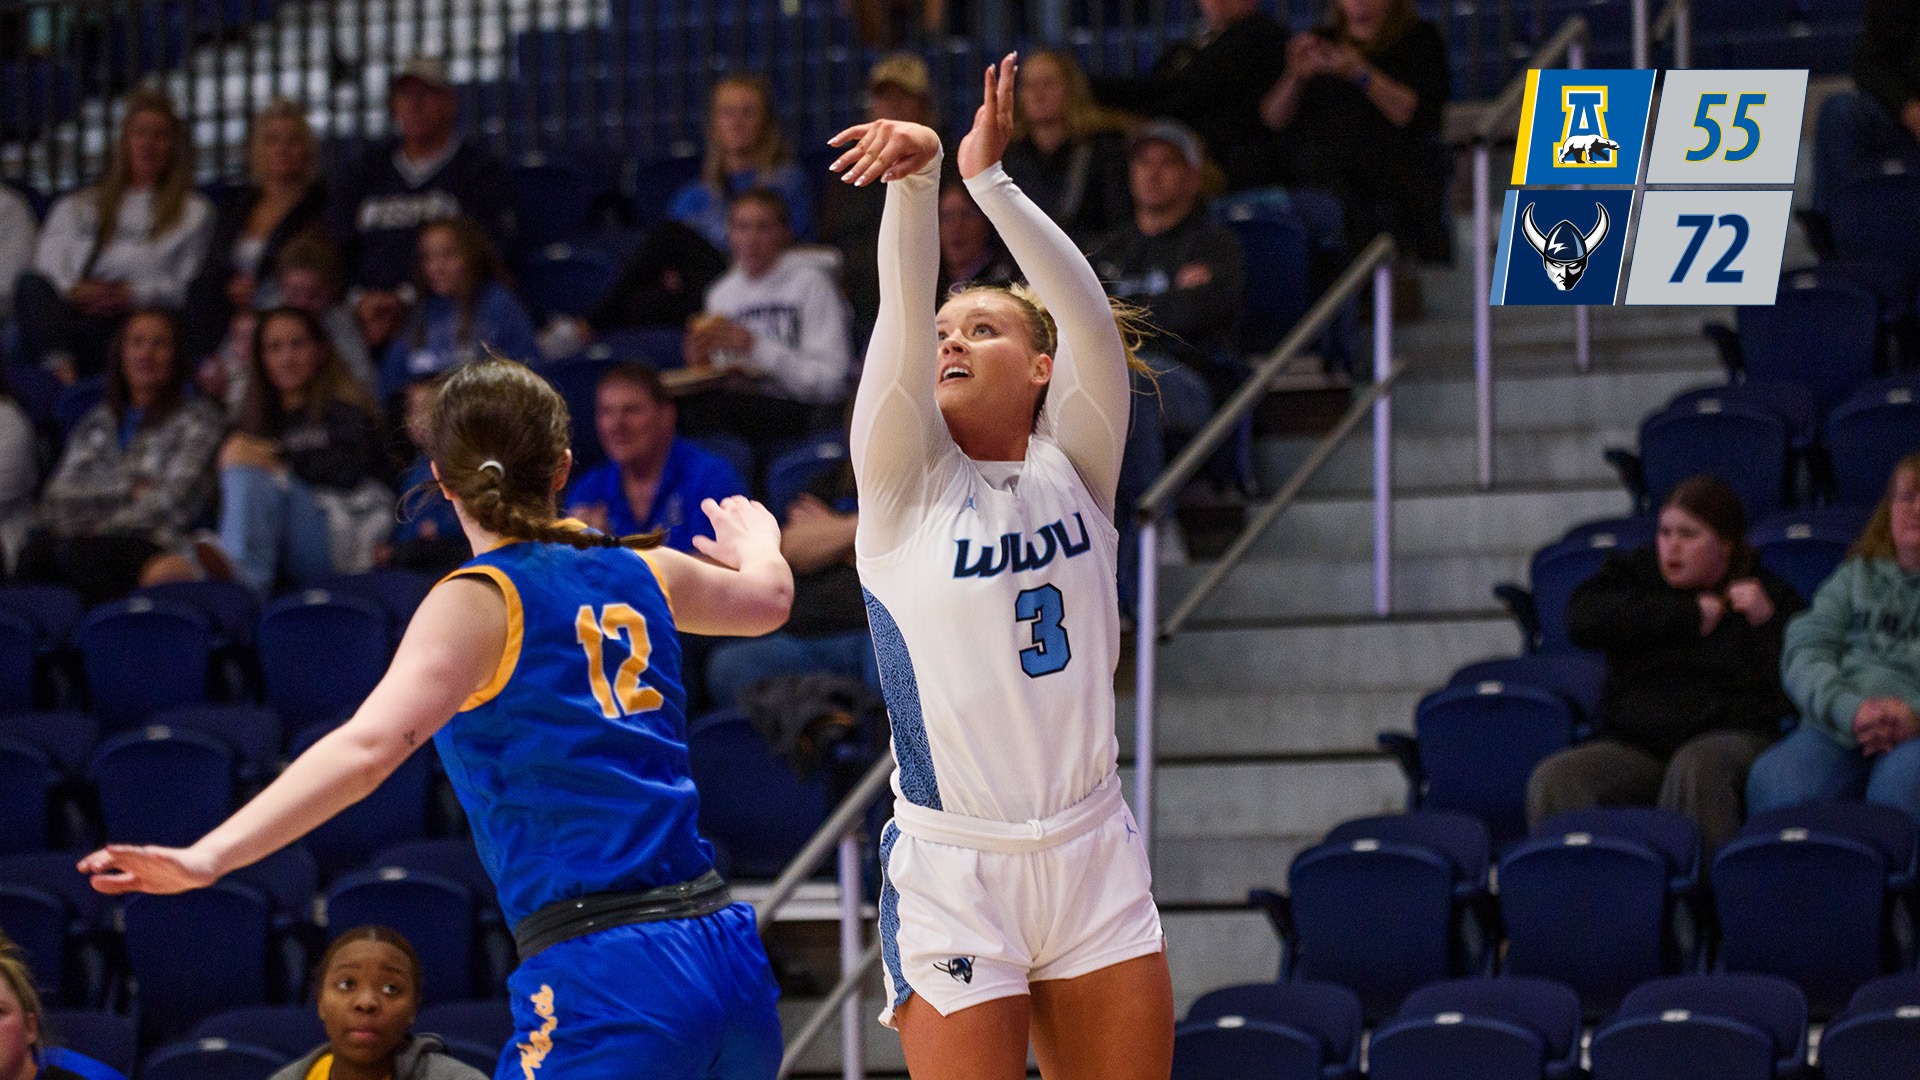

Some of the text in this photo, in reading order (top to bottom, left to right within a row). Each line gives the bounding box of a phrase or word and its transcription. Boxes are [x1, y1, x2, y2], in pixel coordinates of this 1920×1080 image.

[953, 511, 1091, 579] WWU
[575, 603, 664, 718] 12
[1015, 582, 1072, 678] 3
